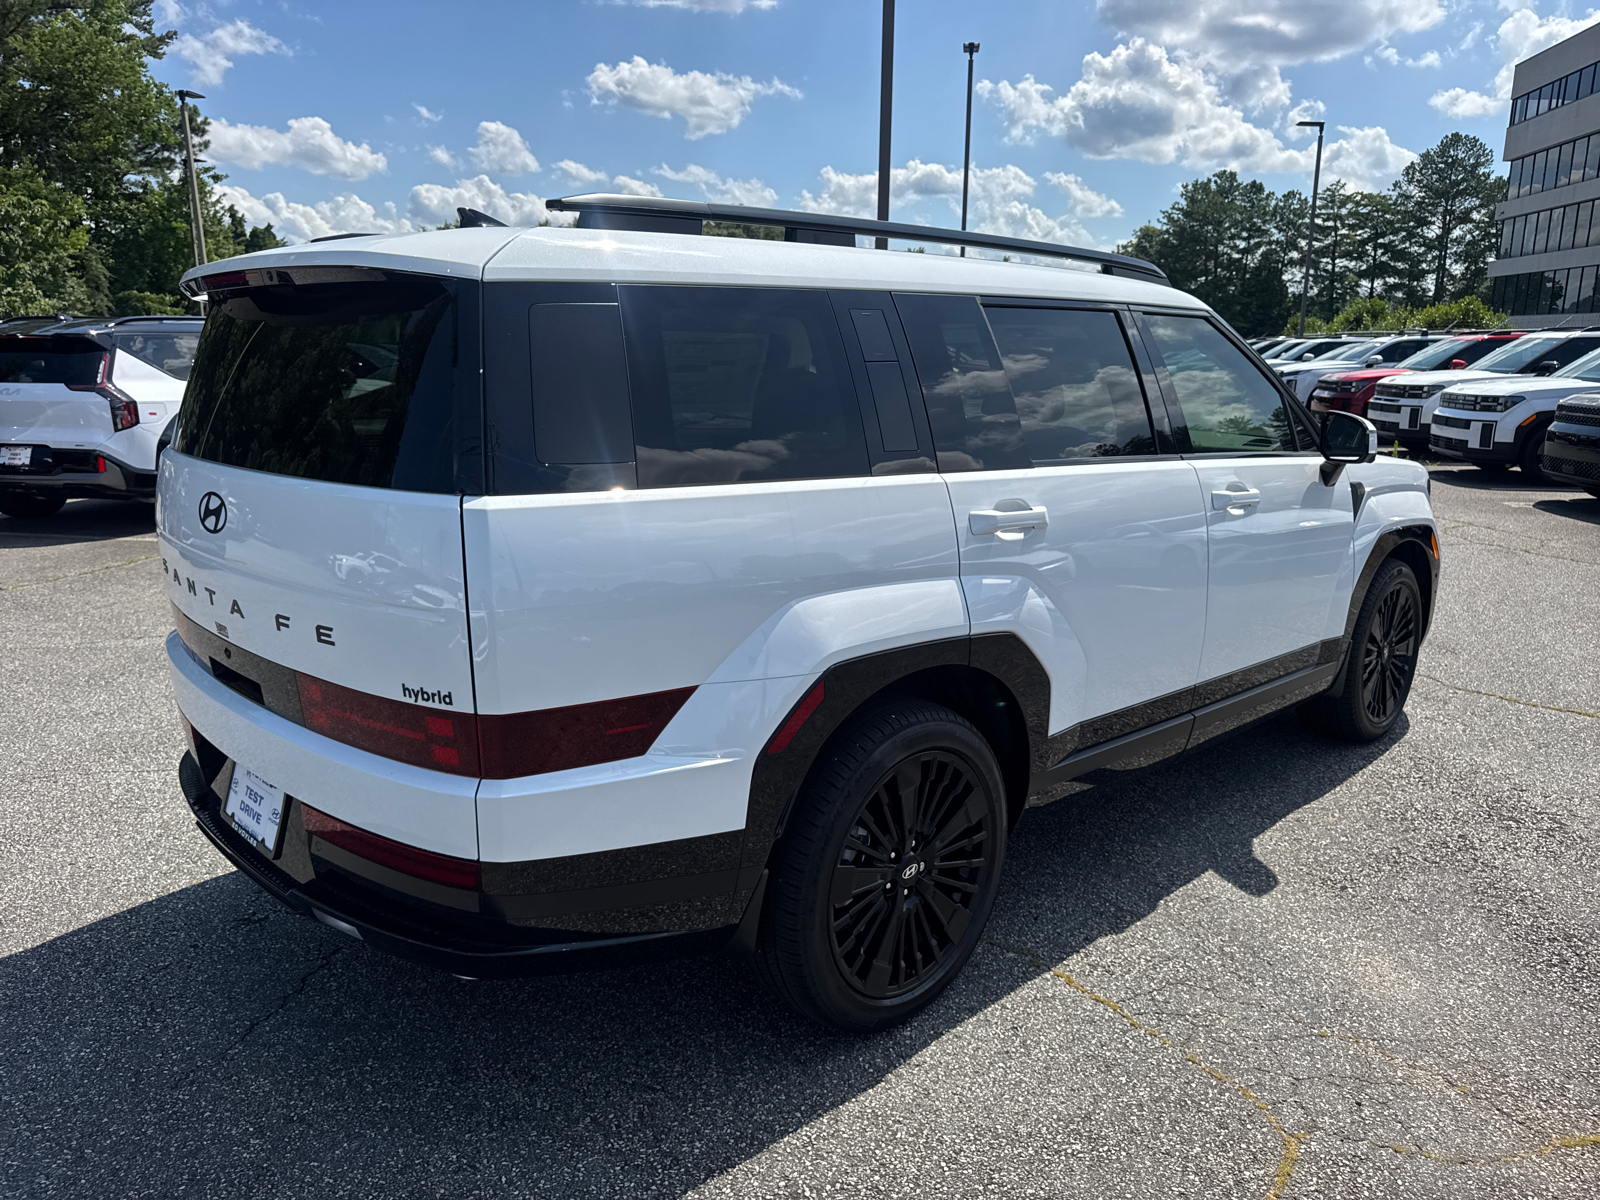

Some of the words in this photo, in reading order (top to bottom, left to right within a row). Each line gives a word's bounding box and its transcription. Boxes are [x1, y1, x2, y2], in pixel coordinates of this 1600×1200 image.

[162, 557, 245, 619] SANTA
[274, 613, 336, 646] FE
[401, 683, 453, 706] hybrid
[245, 785, 265, 807] TEST
[239, 800, 263, 826] DRIVE
